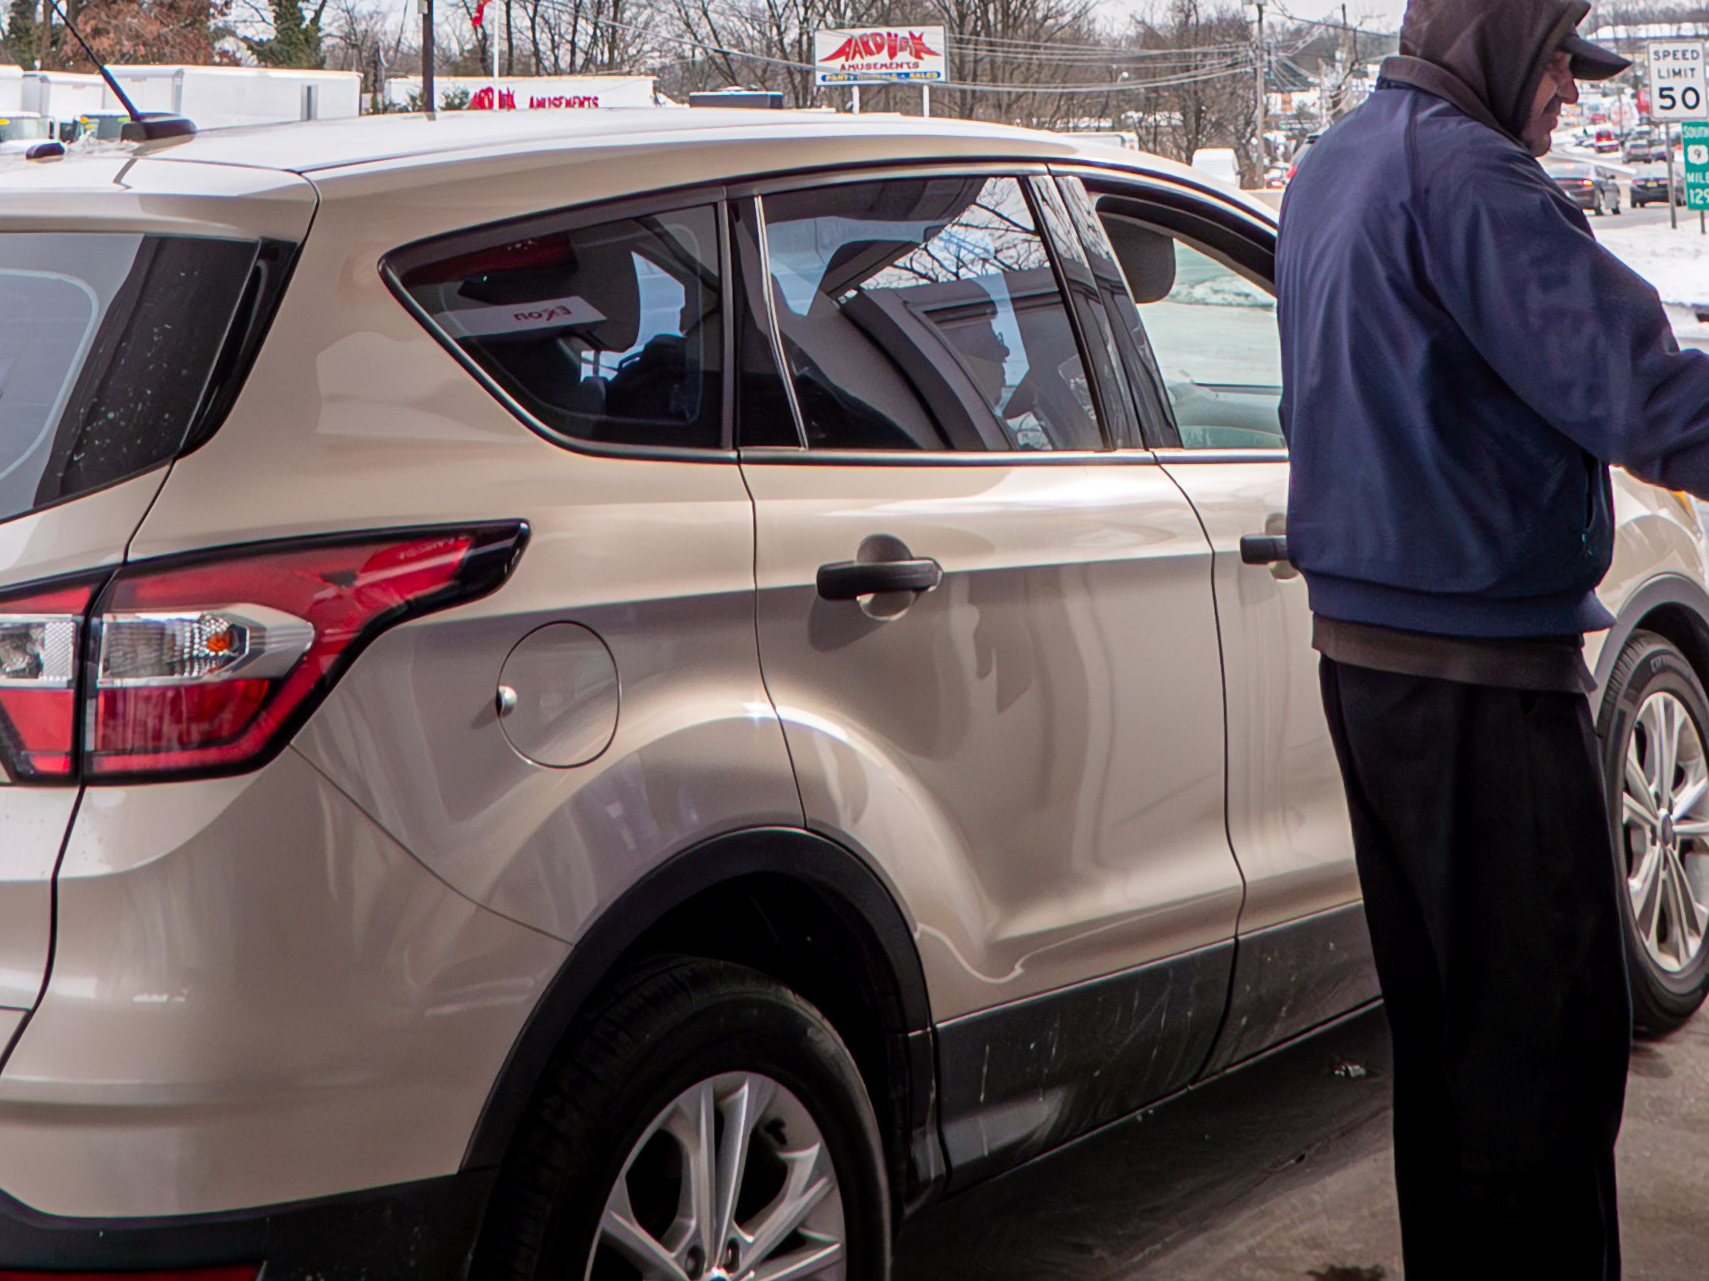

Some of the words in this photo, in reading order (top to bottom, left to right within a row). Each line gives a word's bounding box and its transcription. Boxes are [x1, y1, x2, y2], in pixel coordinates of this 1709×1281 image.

[1653, 49, 1700, 61] SPEED
[839, 62, 920, 72] AMUSEMENTS
[1657, 67, 1696, 79] LIMIT
[1658, 86, 1700, 110] 50
[1683, 125, 1709, 139] SOUTH
[1693, 148, 1702, 160] 9
